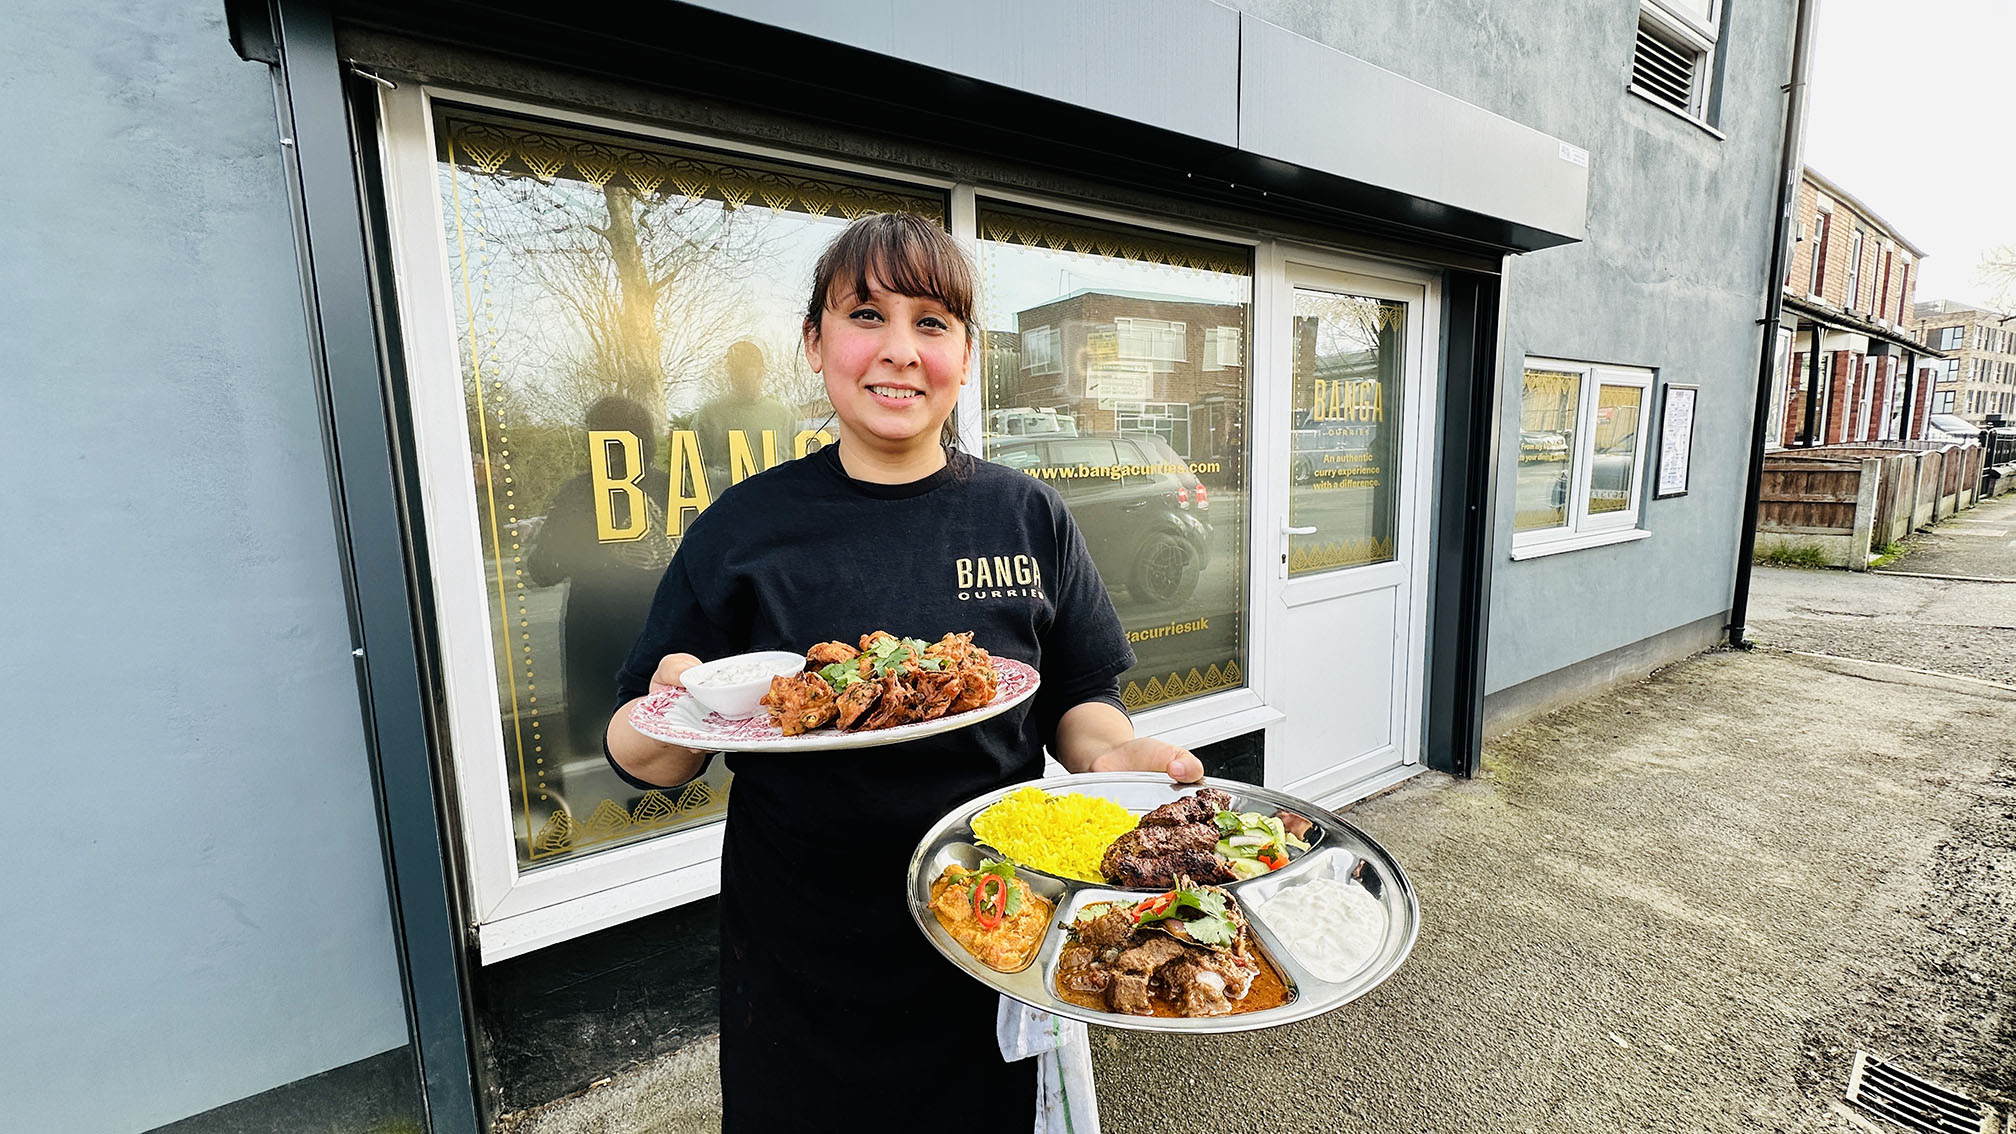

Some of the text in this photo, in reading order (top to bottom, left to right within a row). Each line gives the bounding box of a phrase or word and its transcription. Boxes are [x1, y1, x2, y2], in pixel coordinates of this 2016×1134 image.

[1313, 379, 1384, 423] BANGA
[1323, 452, 1374, 463] An authentic
[1023, 461, 1221, 480] www.bangacurries.com
[1314, 466, 1380, 479] curry experience
[588, 429, 838, 544] BAN
[1313, 480, 1333, 491] with
[956, 554, 1042, 589] BANGA
